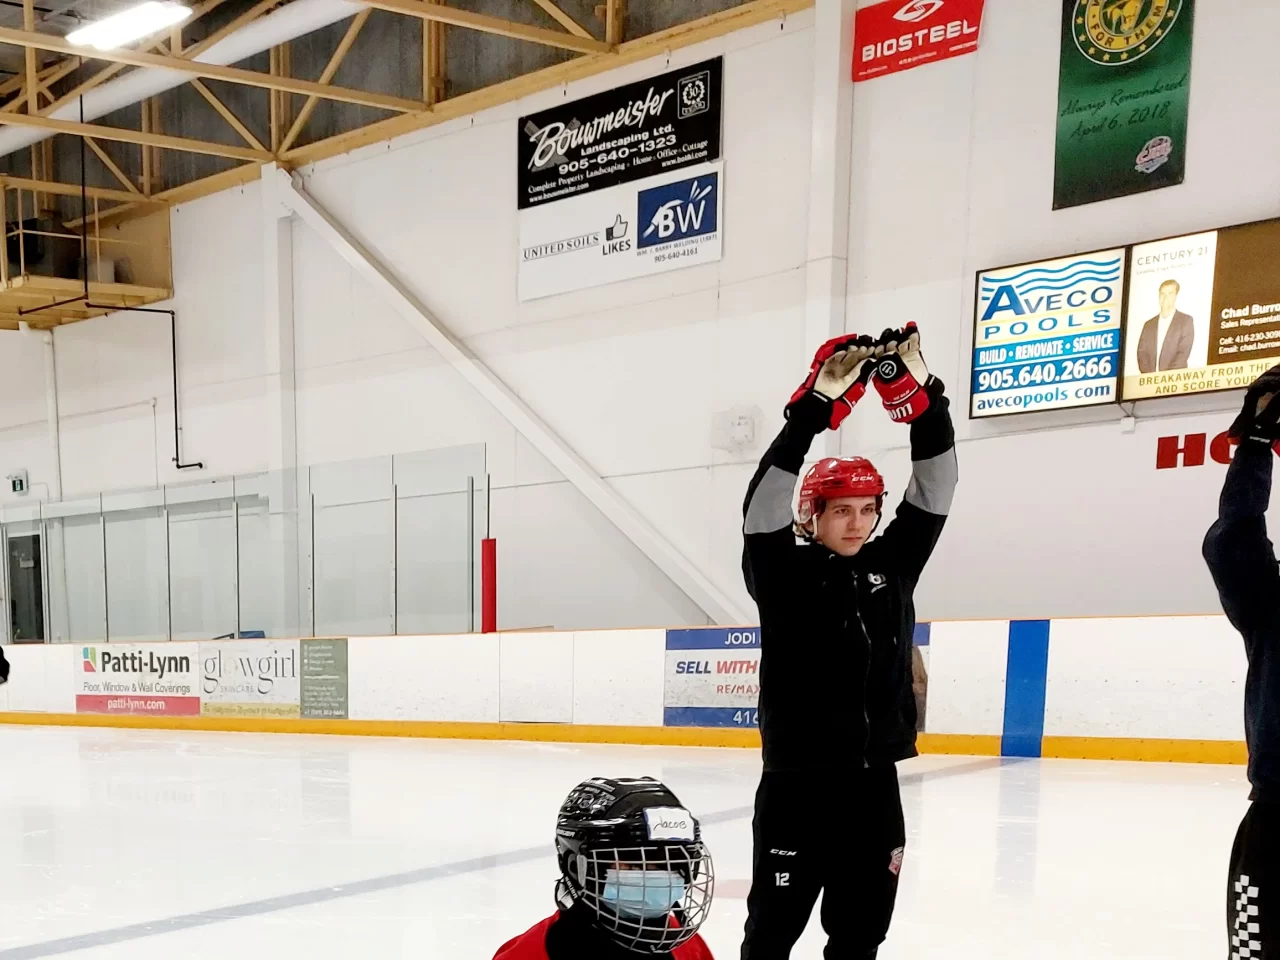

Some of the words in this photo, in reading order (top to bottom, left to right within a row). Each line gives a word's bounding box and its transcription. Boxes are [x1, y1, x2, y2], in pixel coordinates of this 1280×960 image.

[862, 19, 978, 62] BIOSTEEL
[528, 87, 675, 169] Bouwmeister
[581, 131, 649, 157] Landscaping
[653, 124, 675, 137] Ltd.
[558, 134, 677, 175] 905-640-1323
[528, 180, 557, 194] Complete
[658, 199, 706, 238] BW
[524, 242, 564, 260] UNITED
[566, 234, 599, 251] SOILS
[602, 239, 631, 256] LIKES
[1136, 248, 1194, 266] CENTURY
[981, 284, 1113, 322] AVECO
[1221, 305, 1249, 319] Chad
[984, 309, 1112, 340] POOLS
[979, 347, 1007, 365] BUILD
[1015, 339, 1064, 361] RENOVATE
[1072, 332, 1113, 352] SERVICE
[978, 355, 1112, 391] 905.640.2666
[1139, 370, 1207, 387] BREAKAWAY
[1211, 365, 1244, 377] FROM
[1249, 362, 1271, 373] THE
[1155, 384, 1178, 395] AND
[1183, 378, 1220, 392] SCORE
[724, 632, 756, 645] JODI
[101, 650, 190, 679] Patti-Lynn
[676, 661, 711, 674] SELL
[716, 660, 758, 674] WITH
[102, 682, 130, 692] Window
[131, 682, 137, 692] &
[138, 681, 153, 692] Wall
[154, 682, 191, 695] Coverings
[107, 697, 165, 711] patti-lynn.com
[769, 848, 798, 857] CCM
[774, 872, 790, 887] 12
